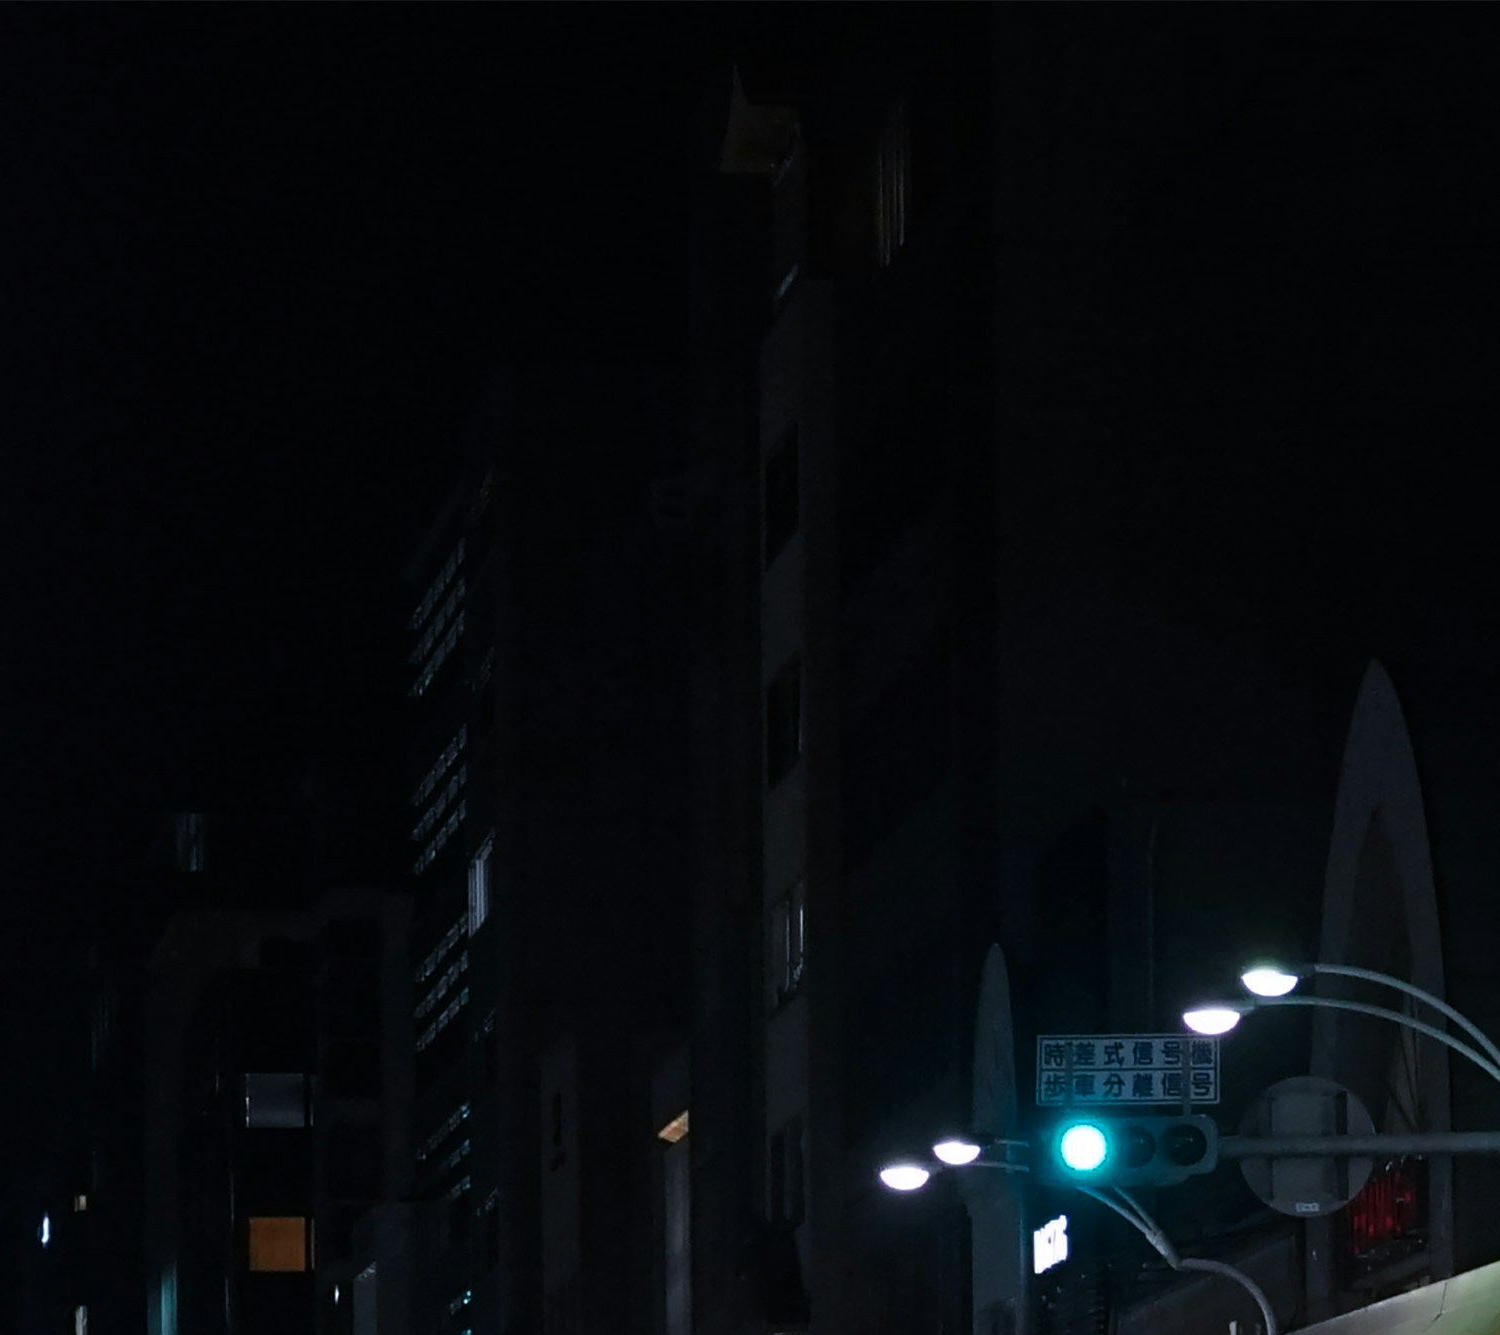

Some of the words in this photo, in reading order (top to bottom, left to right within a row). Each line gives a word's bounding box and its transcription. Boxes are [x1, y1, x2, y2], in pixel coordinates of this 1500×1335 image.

[1044, 1041, 1213, 1067] 時差式信号機
[1045, 1073, 1212, 1098] 歩車分離信号
